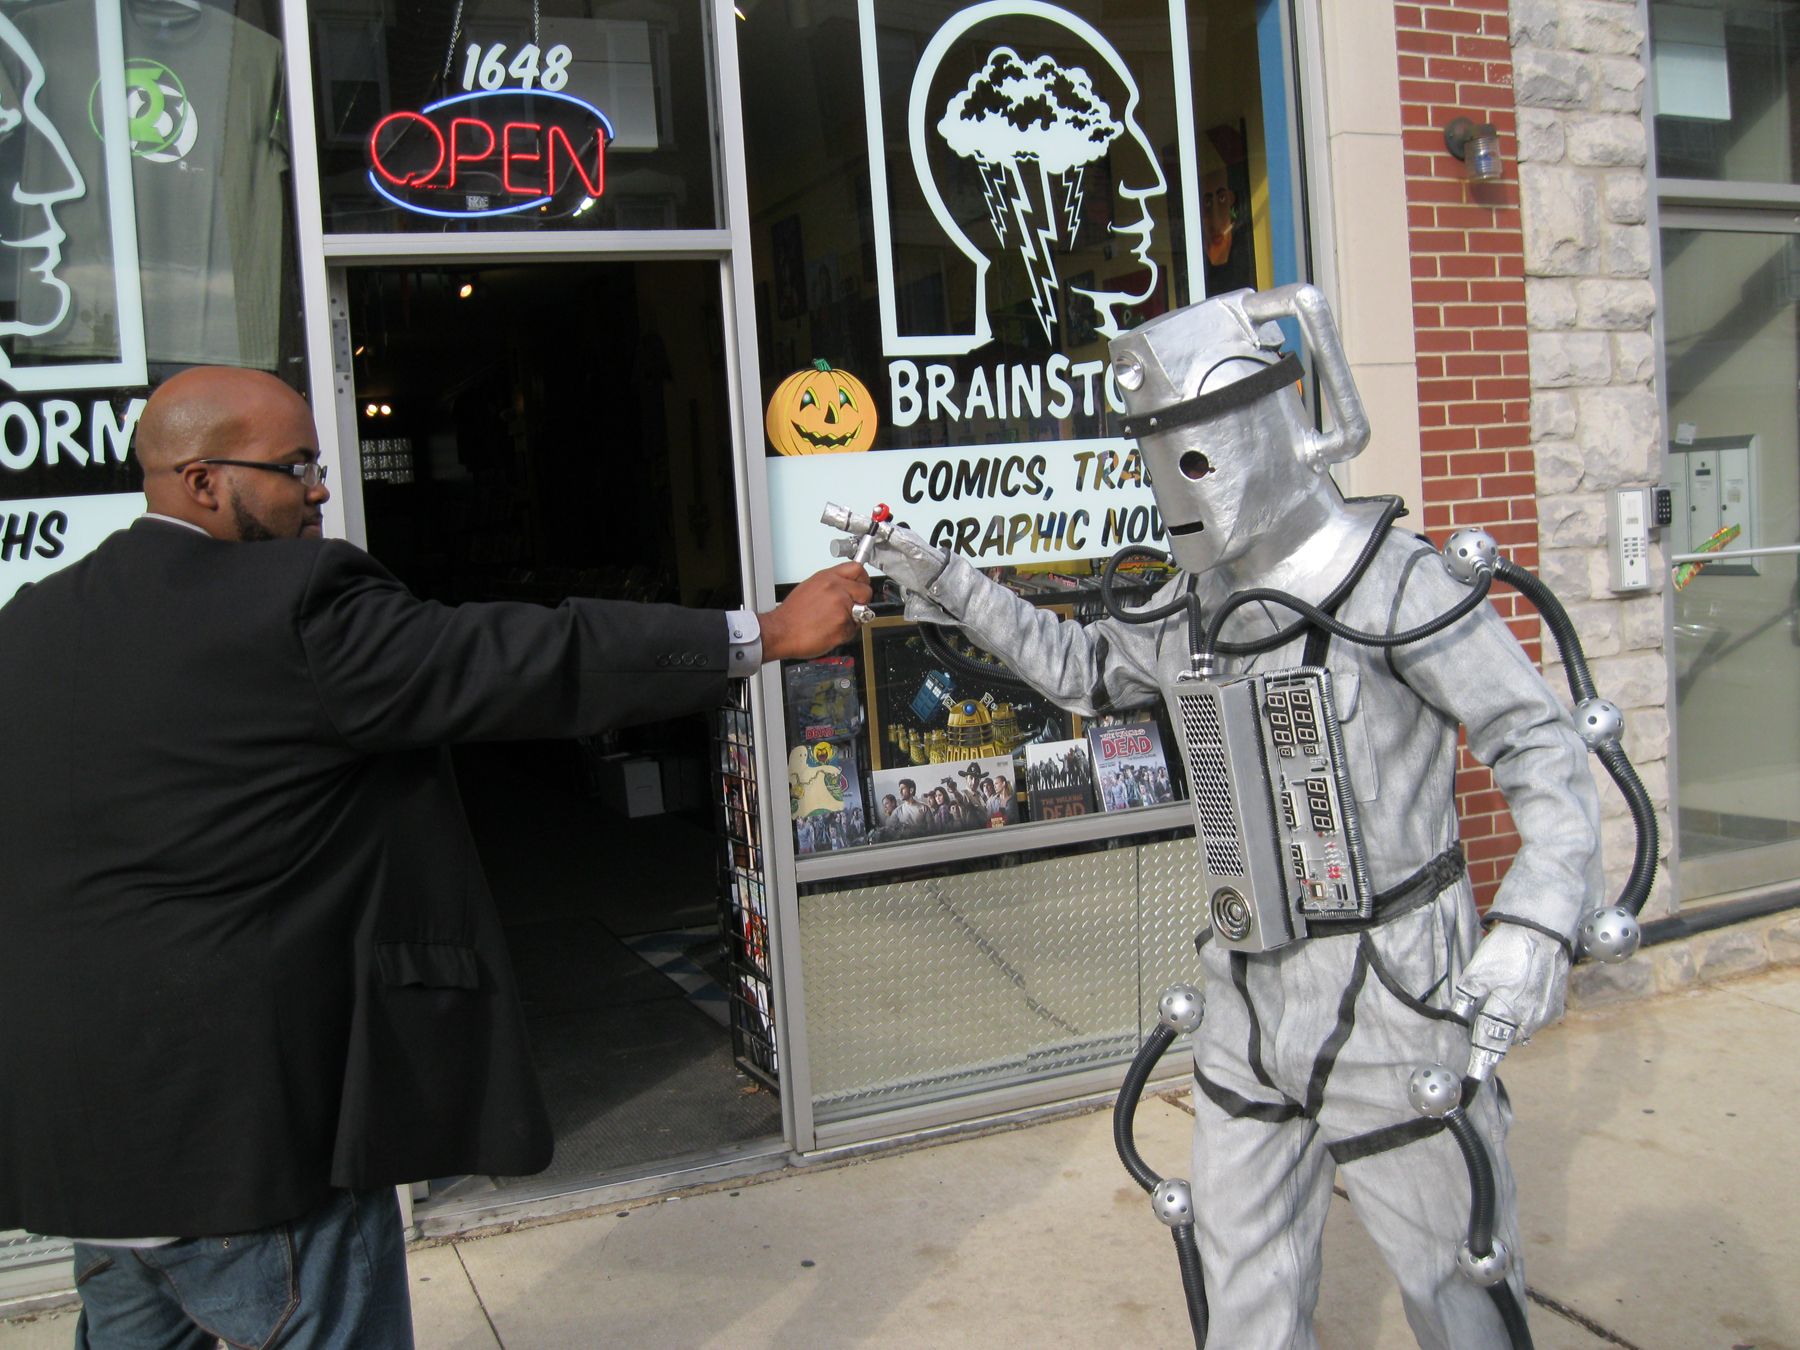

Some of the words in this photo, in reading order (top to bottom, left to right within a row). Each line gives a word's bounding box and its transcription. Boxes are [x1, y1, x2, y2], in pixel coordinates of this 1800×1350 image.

[462, 43, 573, 92] 1648
[371, 112, 605, 197] OPEN
[902, 454, 1054, 504] COMICS,
[1073, 448, 1153, 492] TRA
[0, 509, 69, 562] HS
[930, 509, 1090, 558] GRAPHIC
[1101, 736, 1153, 760] DEAD
